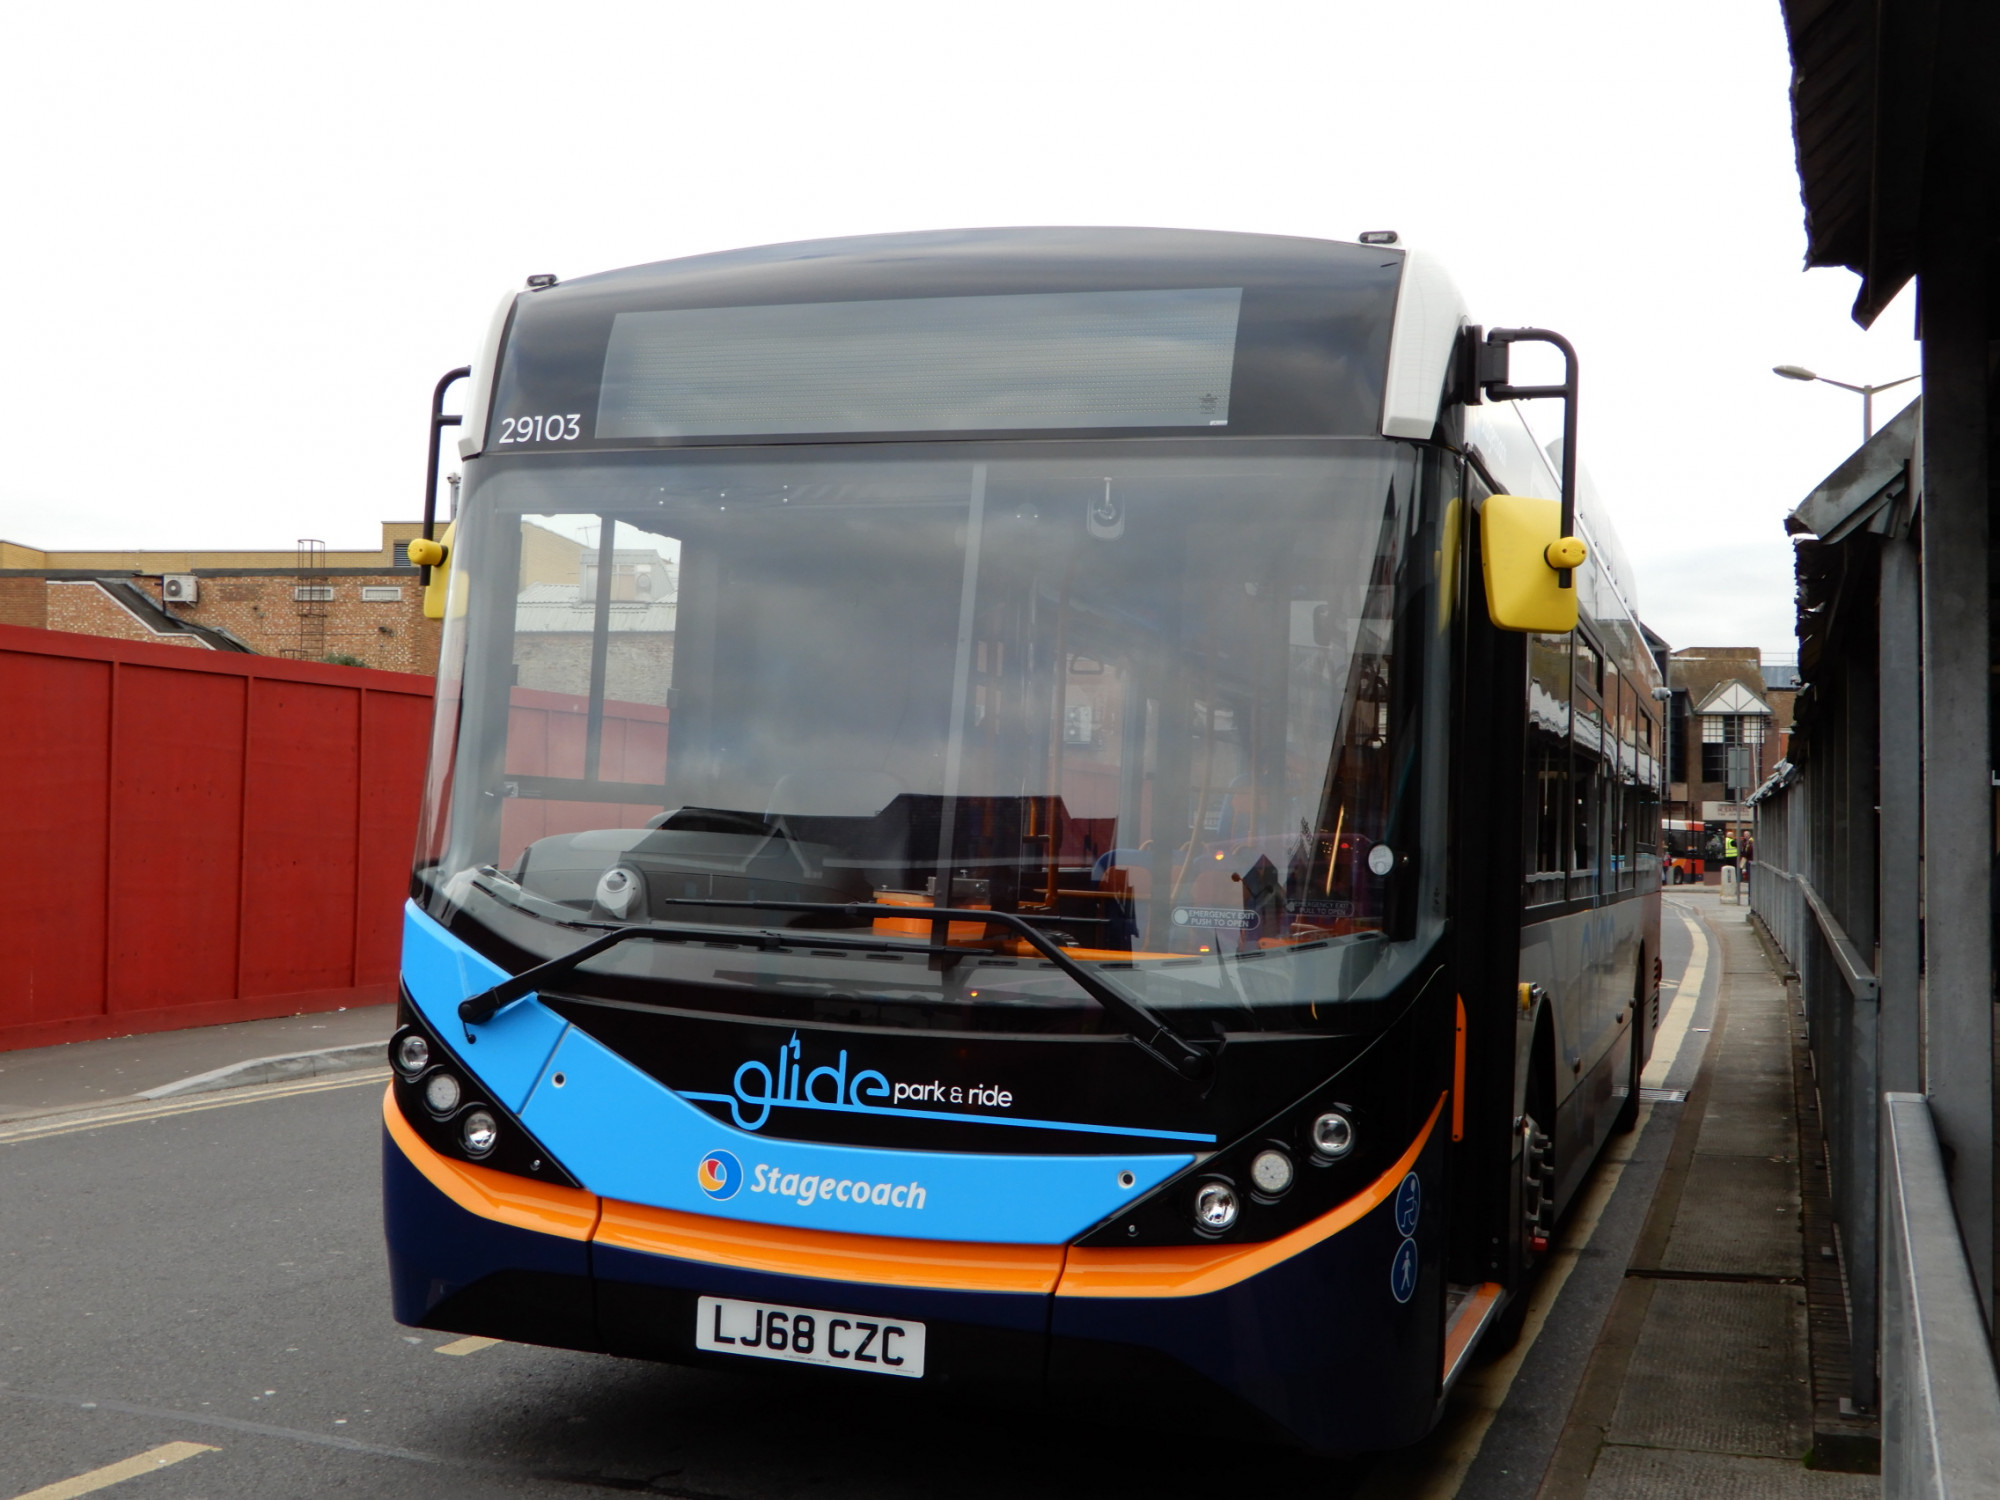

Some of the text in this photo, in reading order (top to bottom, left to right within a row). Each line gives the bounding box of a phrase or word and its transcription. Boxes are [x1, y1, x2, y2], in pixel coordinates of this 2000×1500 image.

[499, 413, 581, 444] 29103
[1189, 909, 1255, 920] EMERGENCY EXIT
[1191, 917, 1249, 928] PUSH TO OPEN
[733, 1030, 1013, 1131] glide park & ride
[750, 1163, 927, 1210] Stagecoach
[713, 1304, 906, 1367] LJ68 CZC
